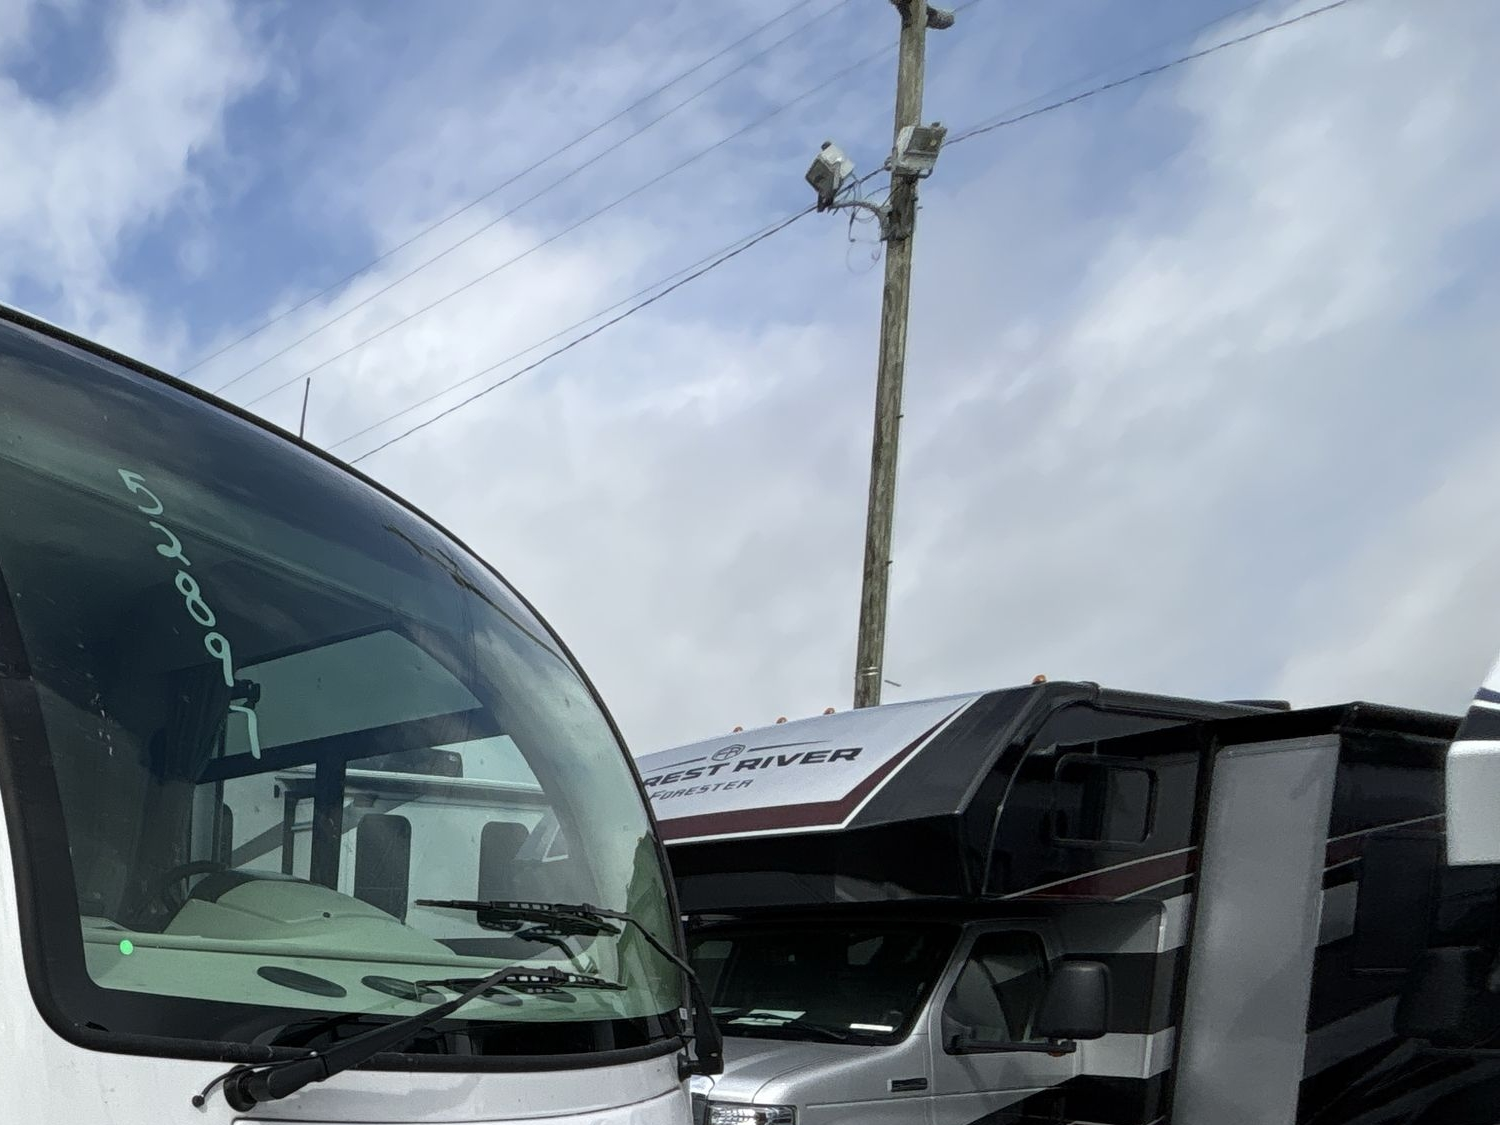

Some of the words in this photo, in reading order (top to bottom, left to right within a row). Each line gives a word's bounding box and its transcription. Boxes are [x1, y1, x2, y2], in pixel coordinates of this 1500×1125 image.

[644, 762, 729, 787] REST
[732, 747, 863, 772] RIVER
[649, 779, 754, 800] FORESTER
